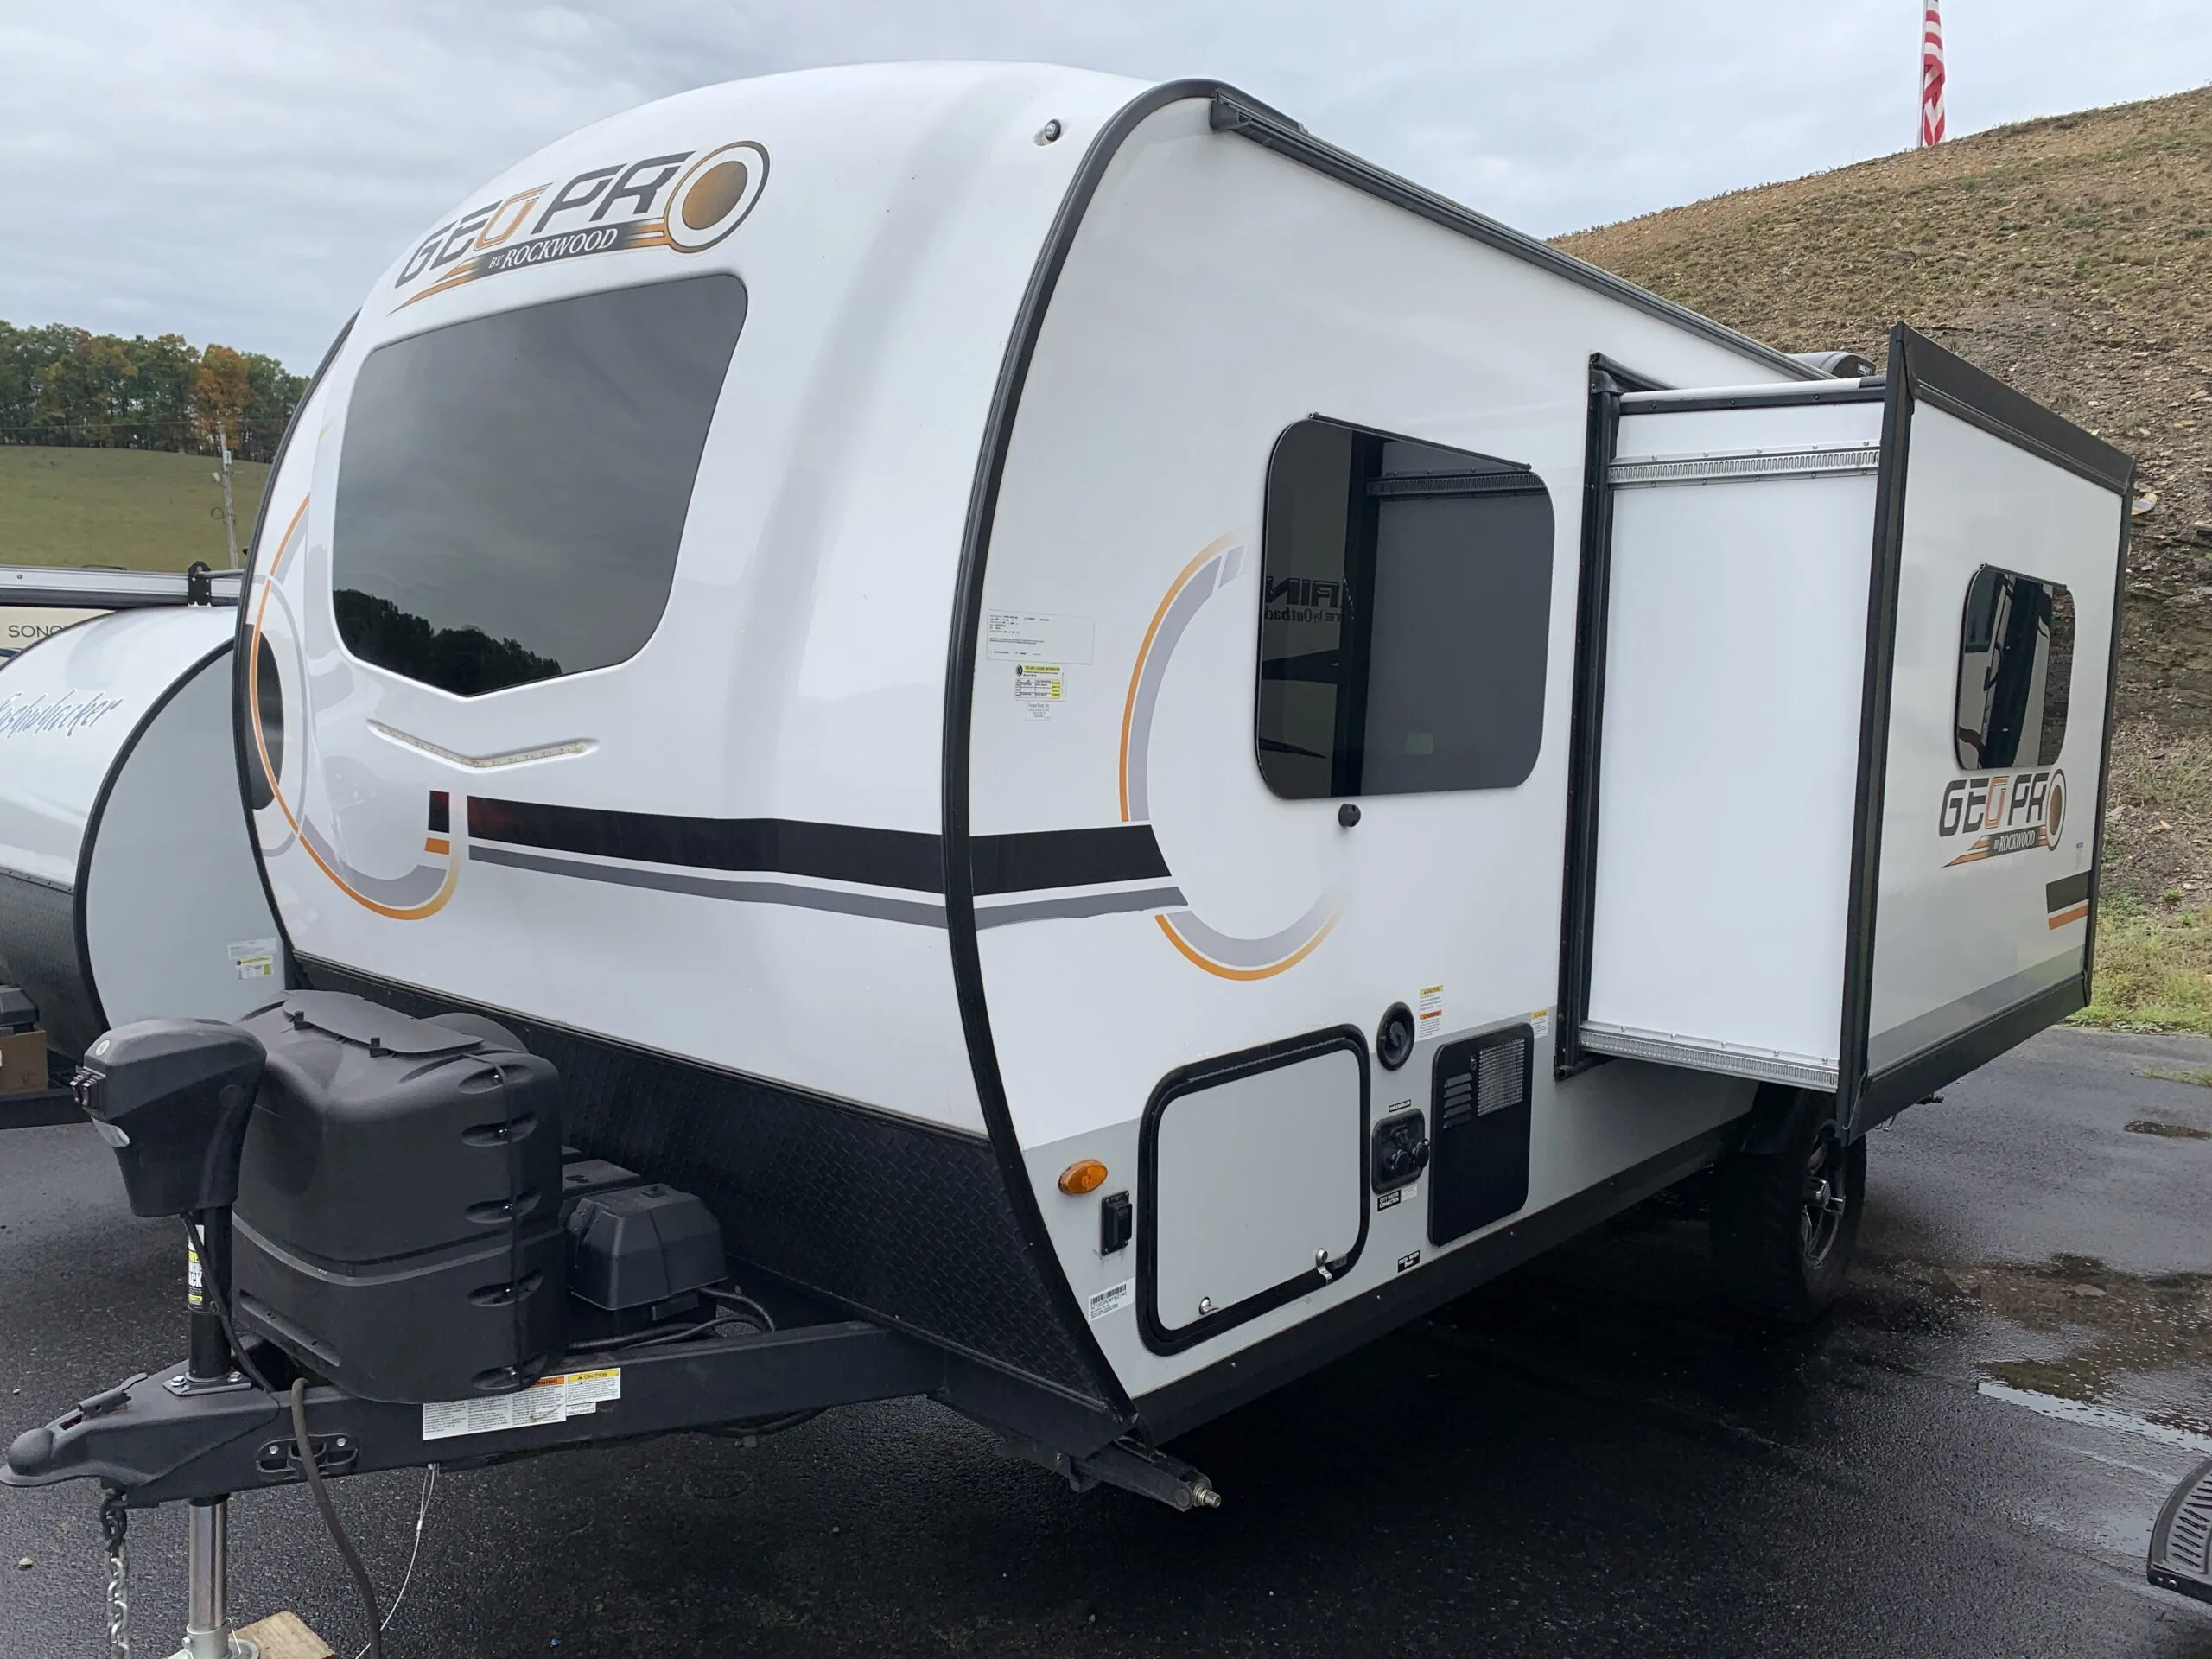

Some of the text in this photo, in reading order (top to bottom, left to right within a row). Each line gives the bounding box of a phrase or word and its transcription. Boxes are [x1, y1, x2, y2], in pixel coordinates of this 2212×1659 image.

[488, 228, 618, 269] BY ROCKWOOD
[1999, 830, 2036, 852] ROCKWOOD
